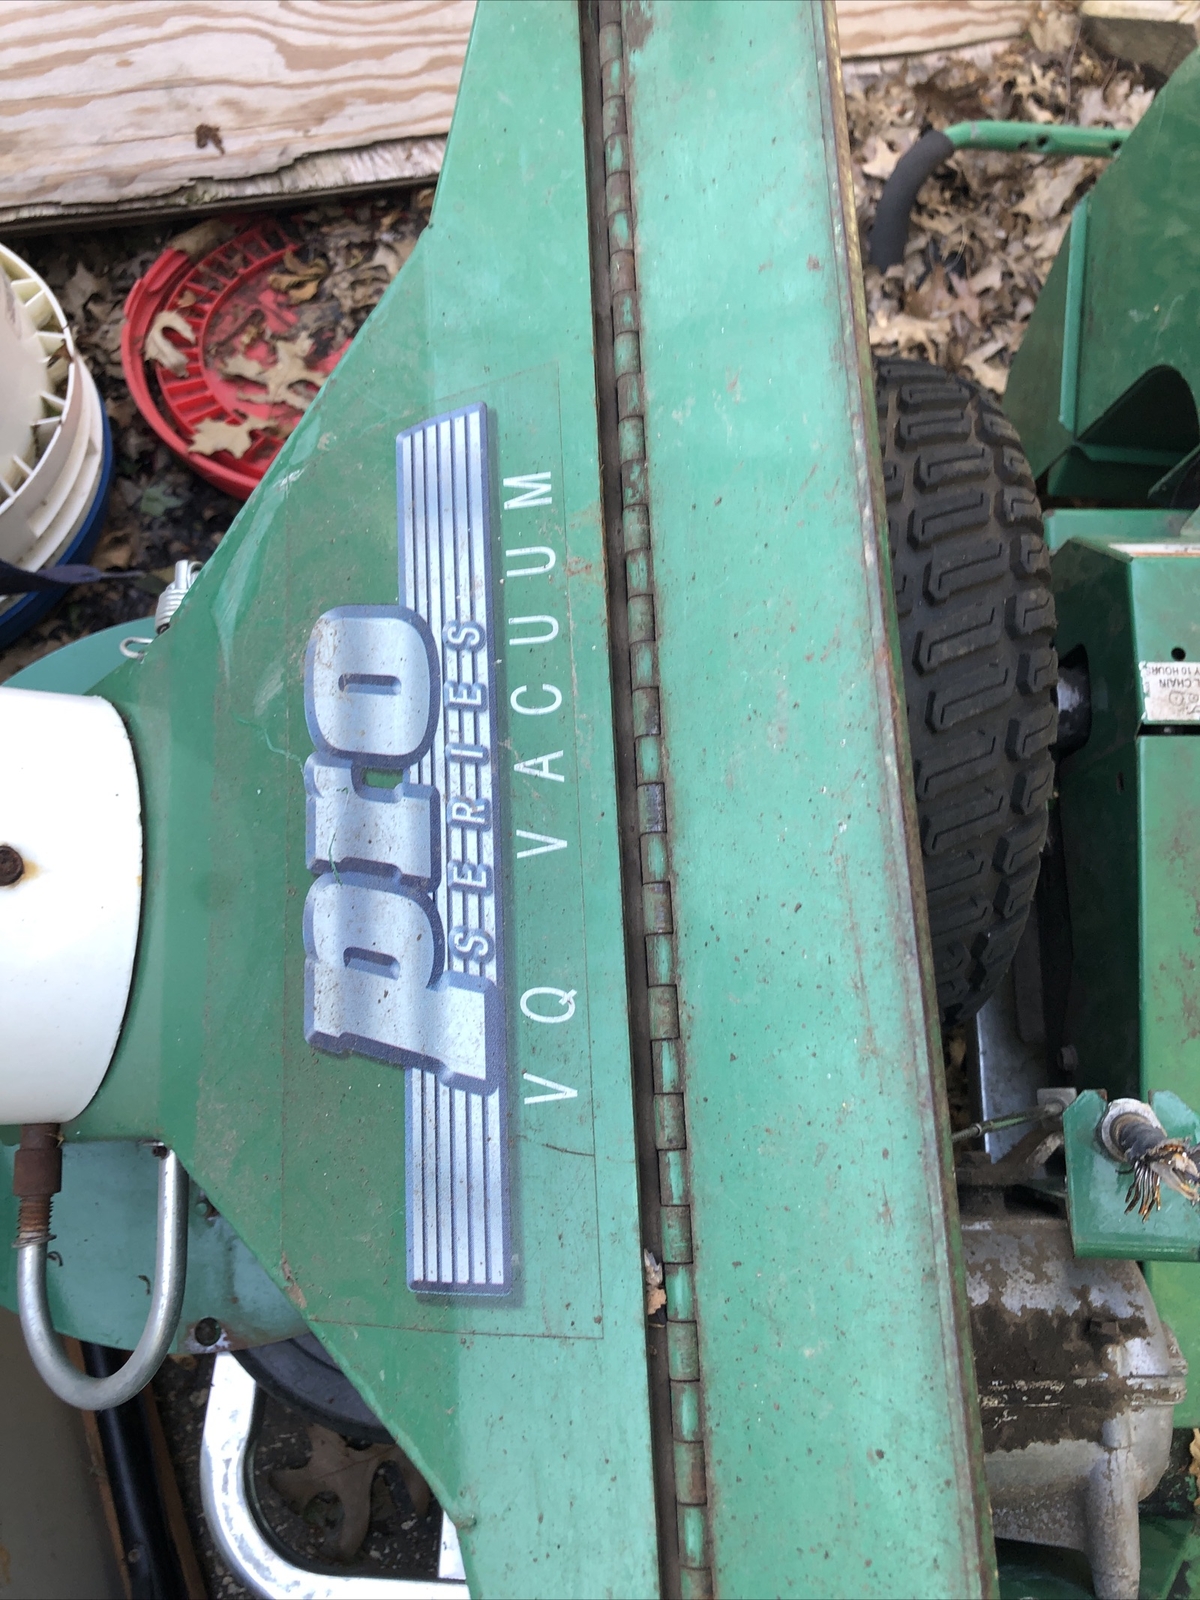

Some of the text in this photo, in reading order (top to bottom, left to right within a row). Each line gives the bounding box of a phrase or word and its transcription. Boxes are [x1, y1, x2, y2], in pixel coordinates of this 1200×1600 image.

[446, 622, 491, 960] SERIES
[501, 470, 578, 1105] VQ VACUUM
[1159, 678, 1192, 688] CHAIN
[1181, 666, 1192, 676] 10
[303, 604, 499, 1096] pro
